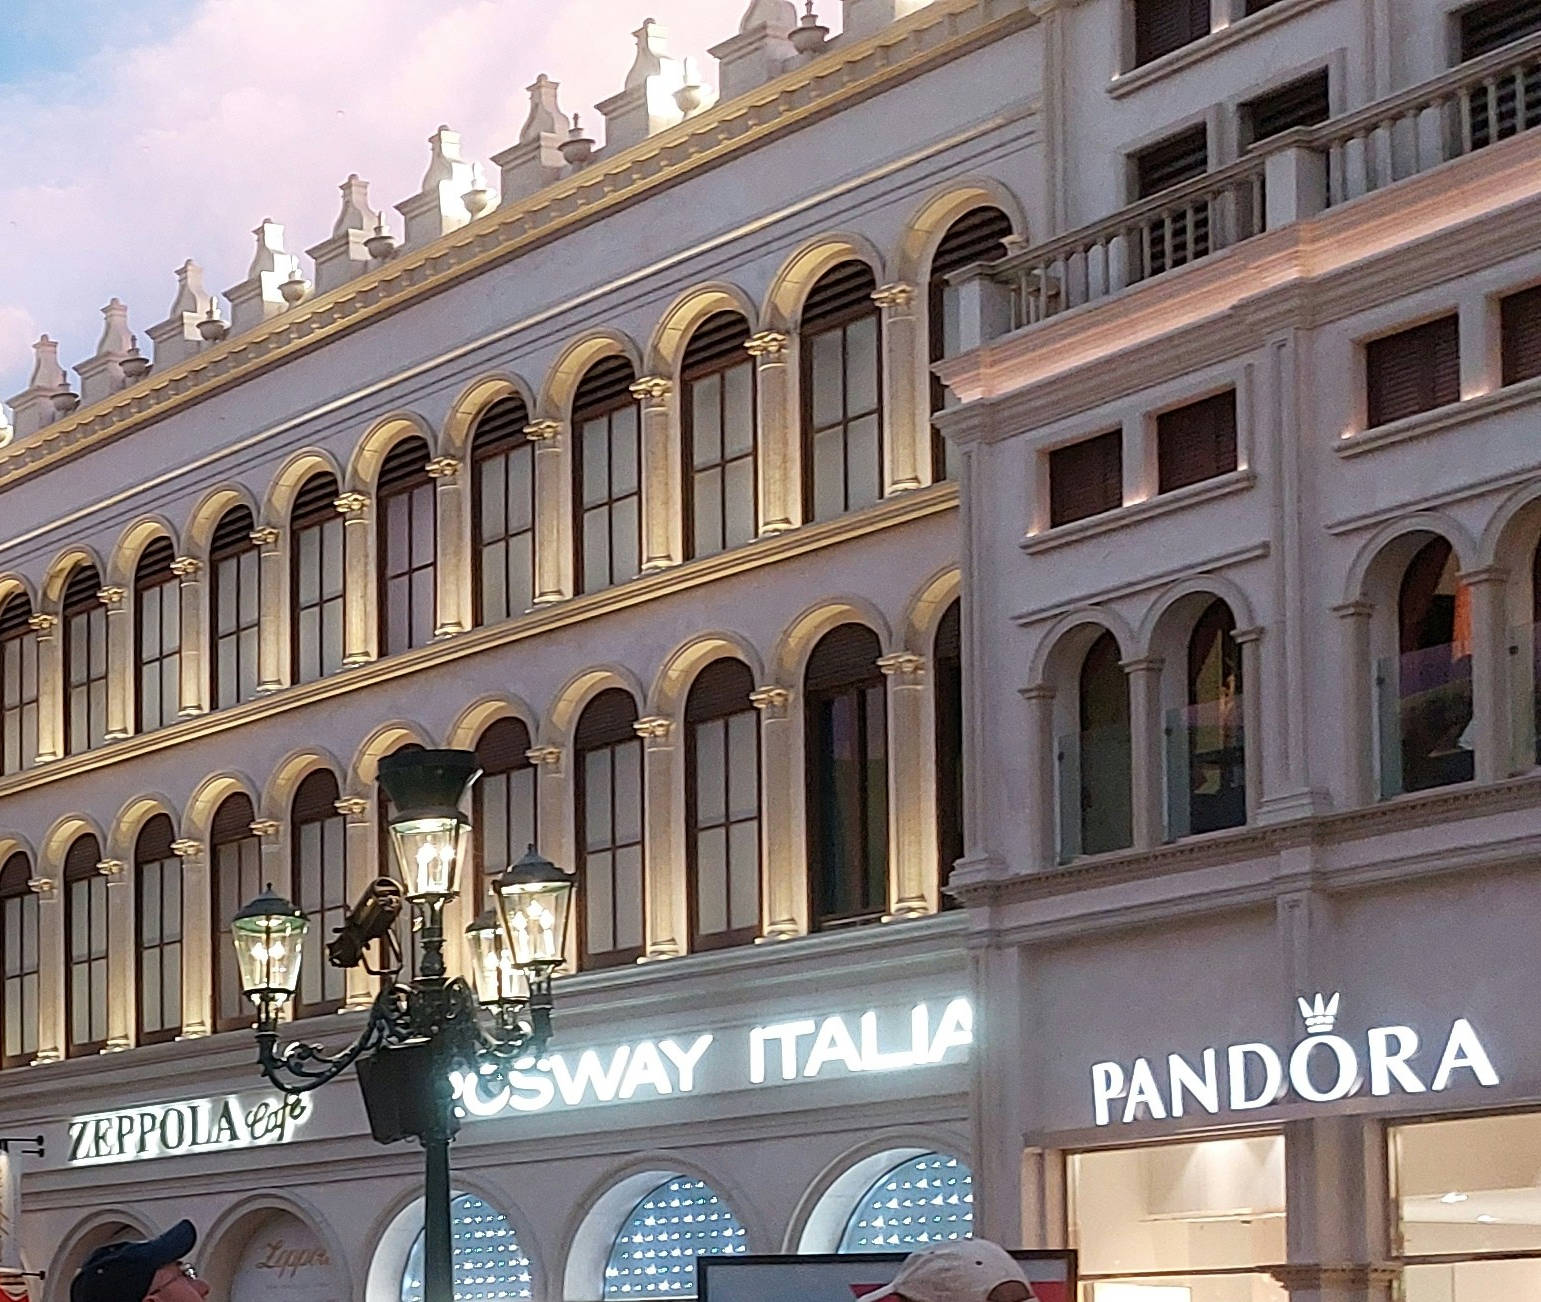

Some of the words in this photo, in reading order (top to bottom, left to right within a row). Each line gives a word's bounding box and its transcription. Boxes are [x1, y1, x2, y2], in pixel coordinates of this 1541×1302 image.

[749, 998, 974, 1085] ITALIA
[1091, 1017, 1501, 1126] PANDORA
[68, 1100, 242, 1162] ZEPPOLA
